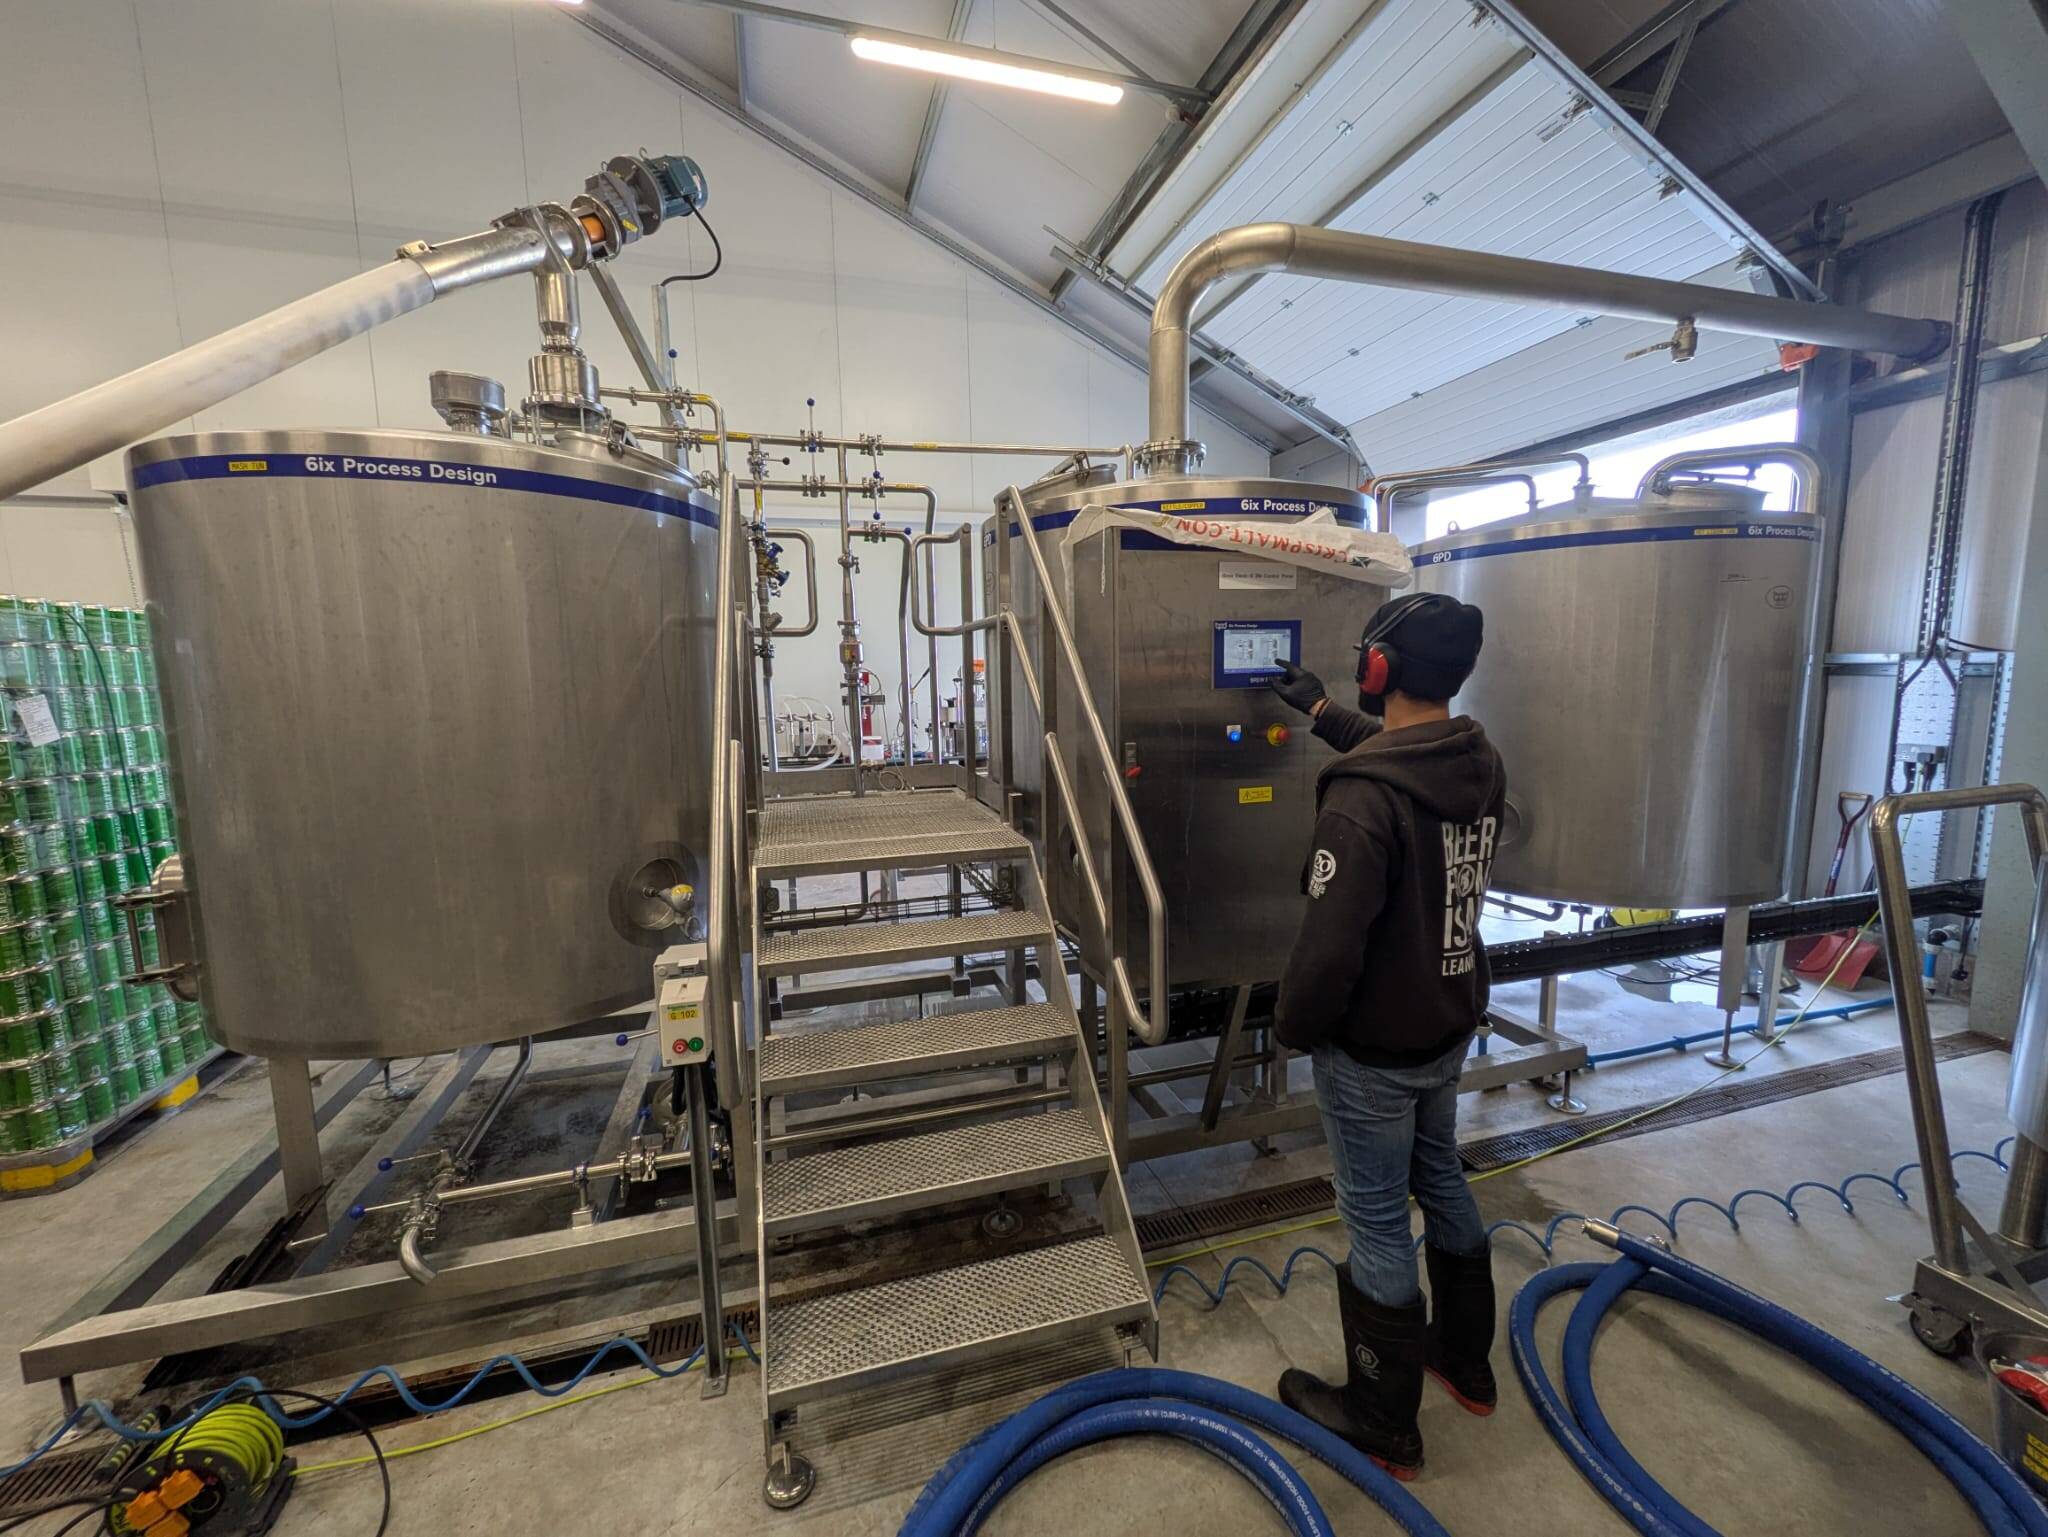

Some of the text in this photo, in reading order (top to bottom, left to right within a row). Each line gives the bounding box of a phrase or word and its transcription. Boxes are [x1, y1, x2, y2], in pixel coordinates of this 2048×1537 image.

[305, 456, 497, 486] 6ix Process Design
[1240, 499, 1260, 511] 6ix
[1263, 499, 1306, 513] Process
[1748, 525, 1763, 536] 6ix
[1765, 525, 1796, 536] Process
[1442, 816, 1497, 868] BEER
